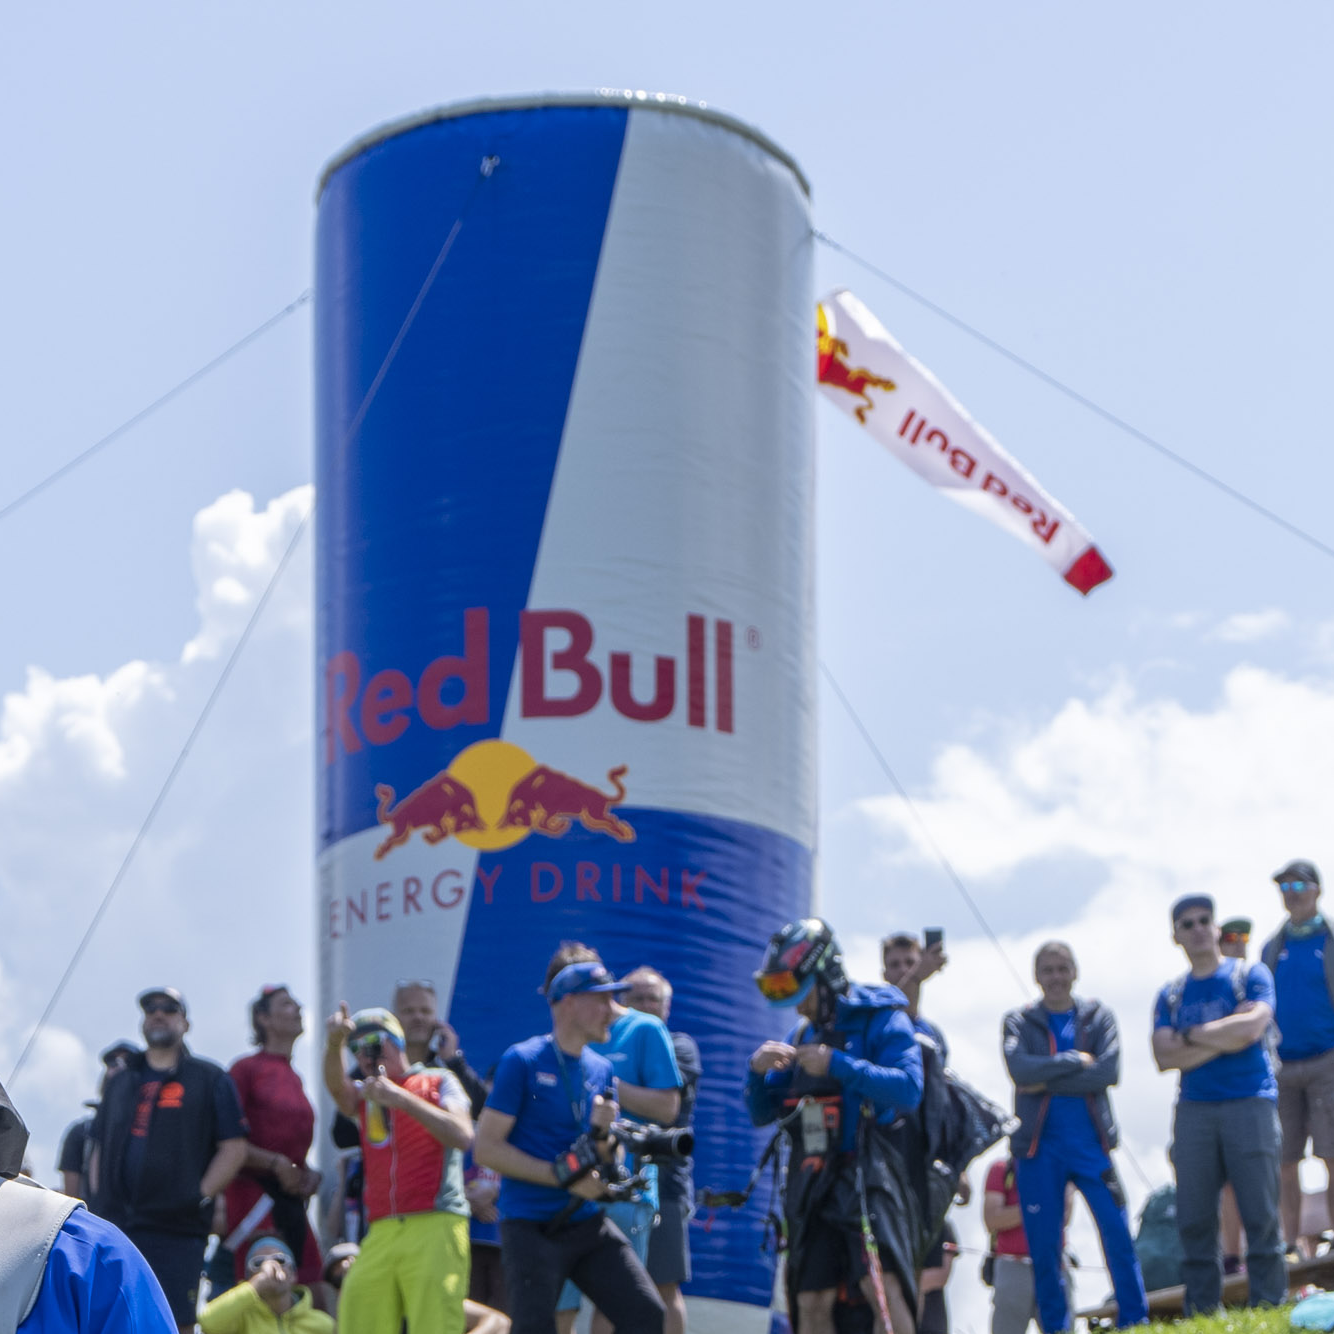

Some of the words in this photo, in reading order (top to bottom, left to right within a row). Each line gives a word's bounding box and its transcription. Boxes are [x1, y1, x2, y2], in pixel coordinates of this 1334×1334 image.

[897, 410, 977, 479] Bull
[980, 472, 1060, 544] Red
[324, 606, 489, 765] Red
[519, 609, 734, 734] Bull
[329, 863, 504, 940] ENERGY
[530, 861, 708, 910] DRINK
